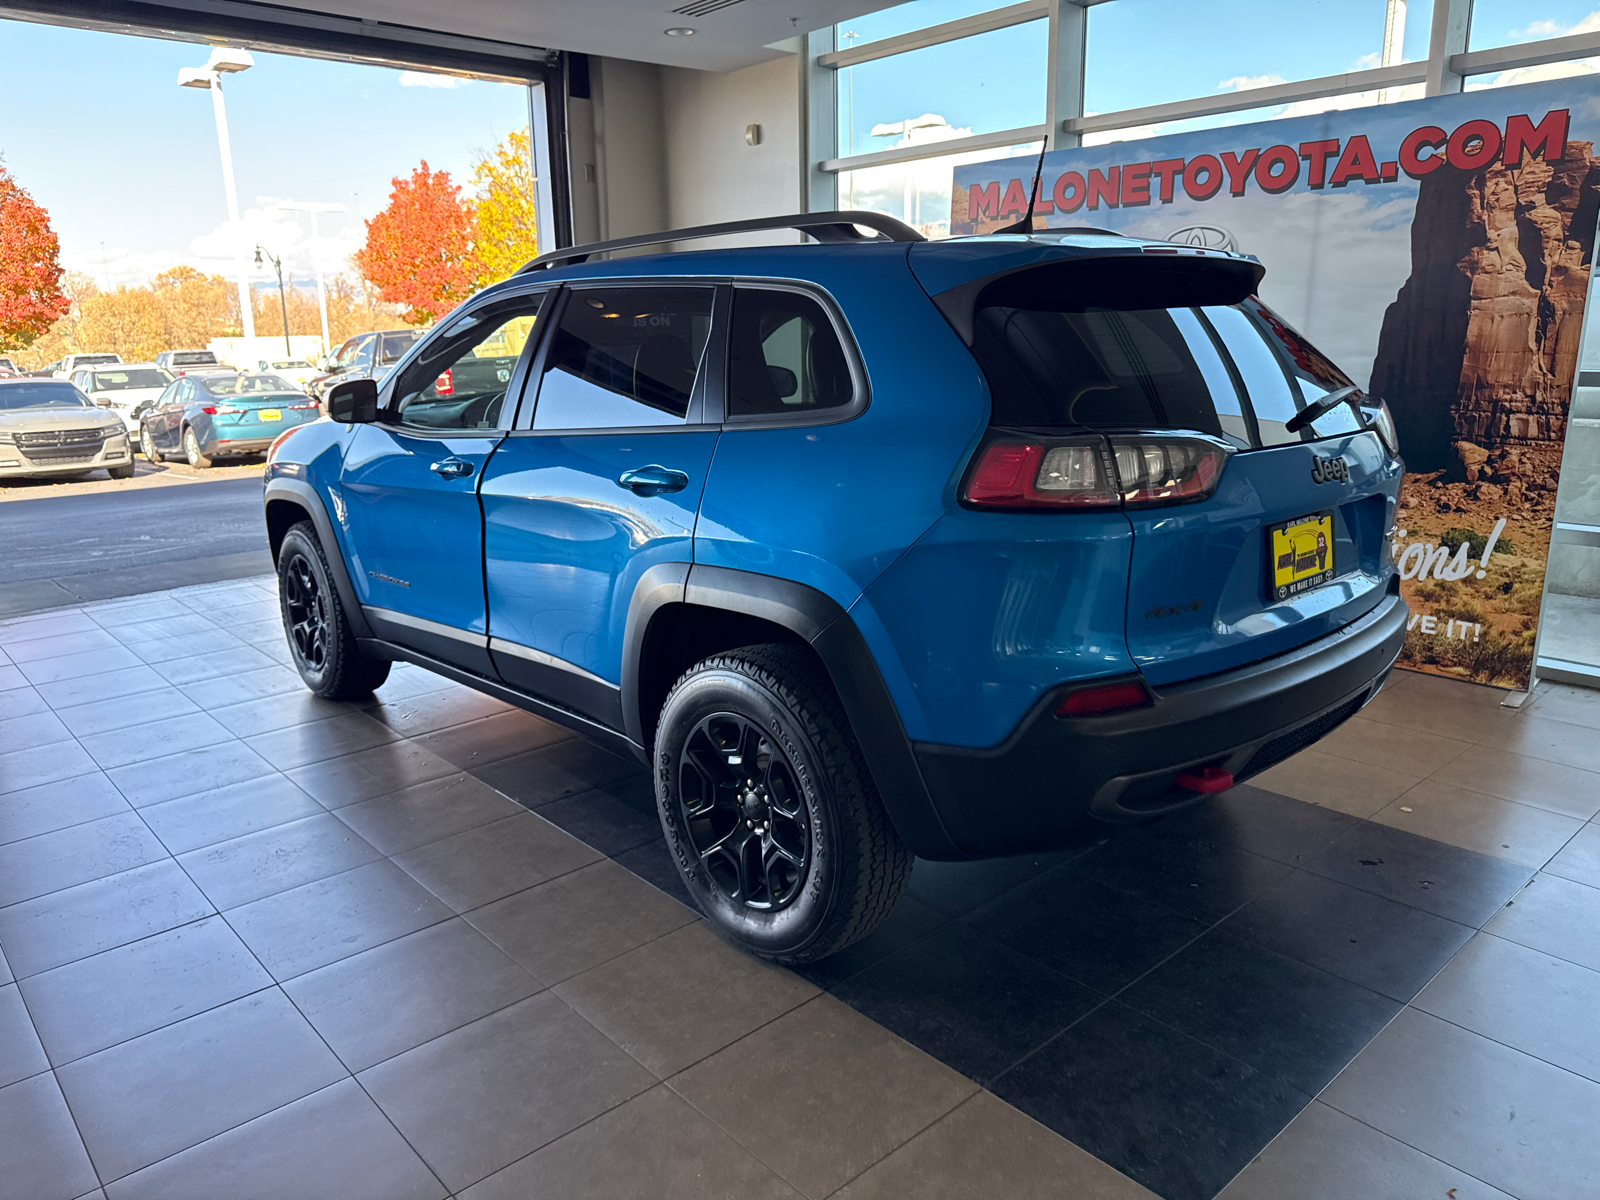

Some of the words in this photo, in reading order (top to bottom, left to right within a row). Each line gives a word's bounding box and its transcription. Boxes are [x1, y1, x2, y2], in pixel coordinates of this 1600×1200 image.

[968, 109, 1571, 220] MALONETOYOTA.COM
[1311, 455, 1349, 485] Jeep
[1318, 537, 1325, 547] 32
[1290, 584, 1297, 594] WE
[1297, 579, 1308, 590] MAKE
[1309, 577, 1313, 587] IT
[1313, 574, 1323, 585] EASY
[1446, 619, 1481, 642] IT!
